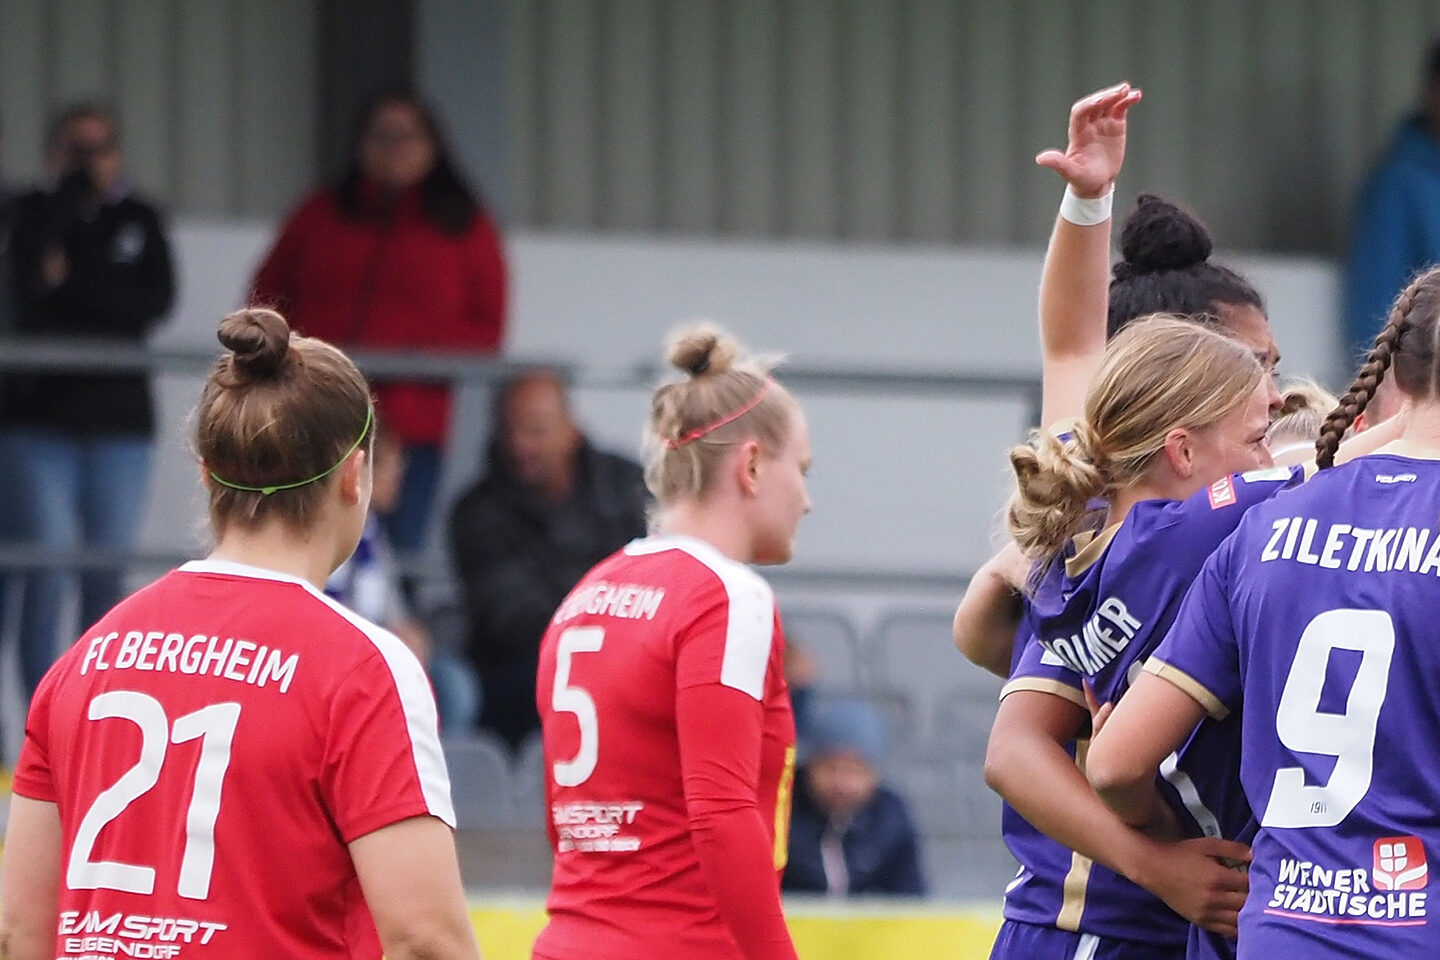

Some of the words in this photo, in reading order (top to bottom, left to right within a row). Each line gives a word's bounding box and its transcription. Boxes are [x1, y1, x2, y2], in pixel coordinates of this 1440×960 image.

[81, 631, 118, 676] FC
[115, 631, 299, 694] BERGHEIM
[552, 626, 605, 787] 5
[1261, 608, 1396, 828] 9
[66, 690, 242, 901] 21
[1310, 801, 1327, 814] 1911
[1267, 884, 1429, 919] STÄDTISCHE
